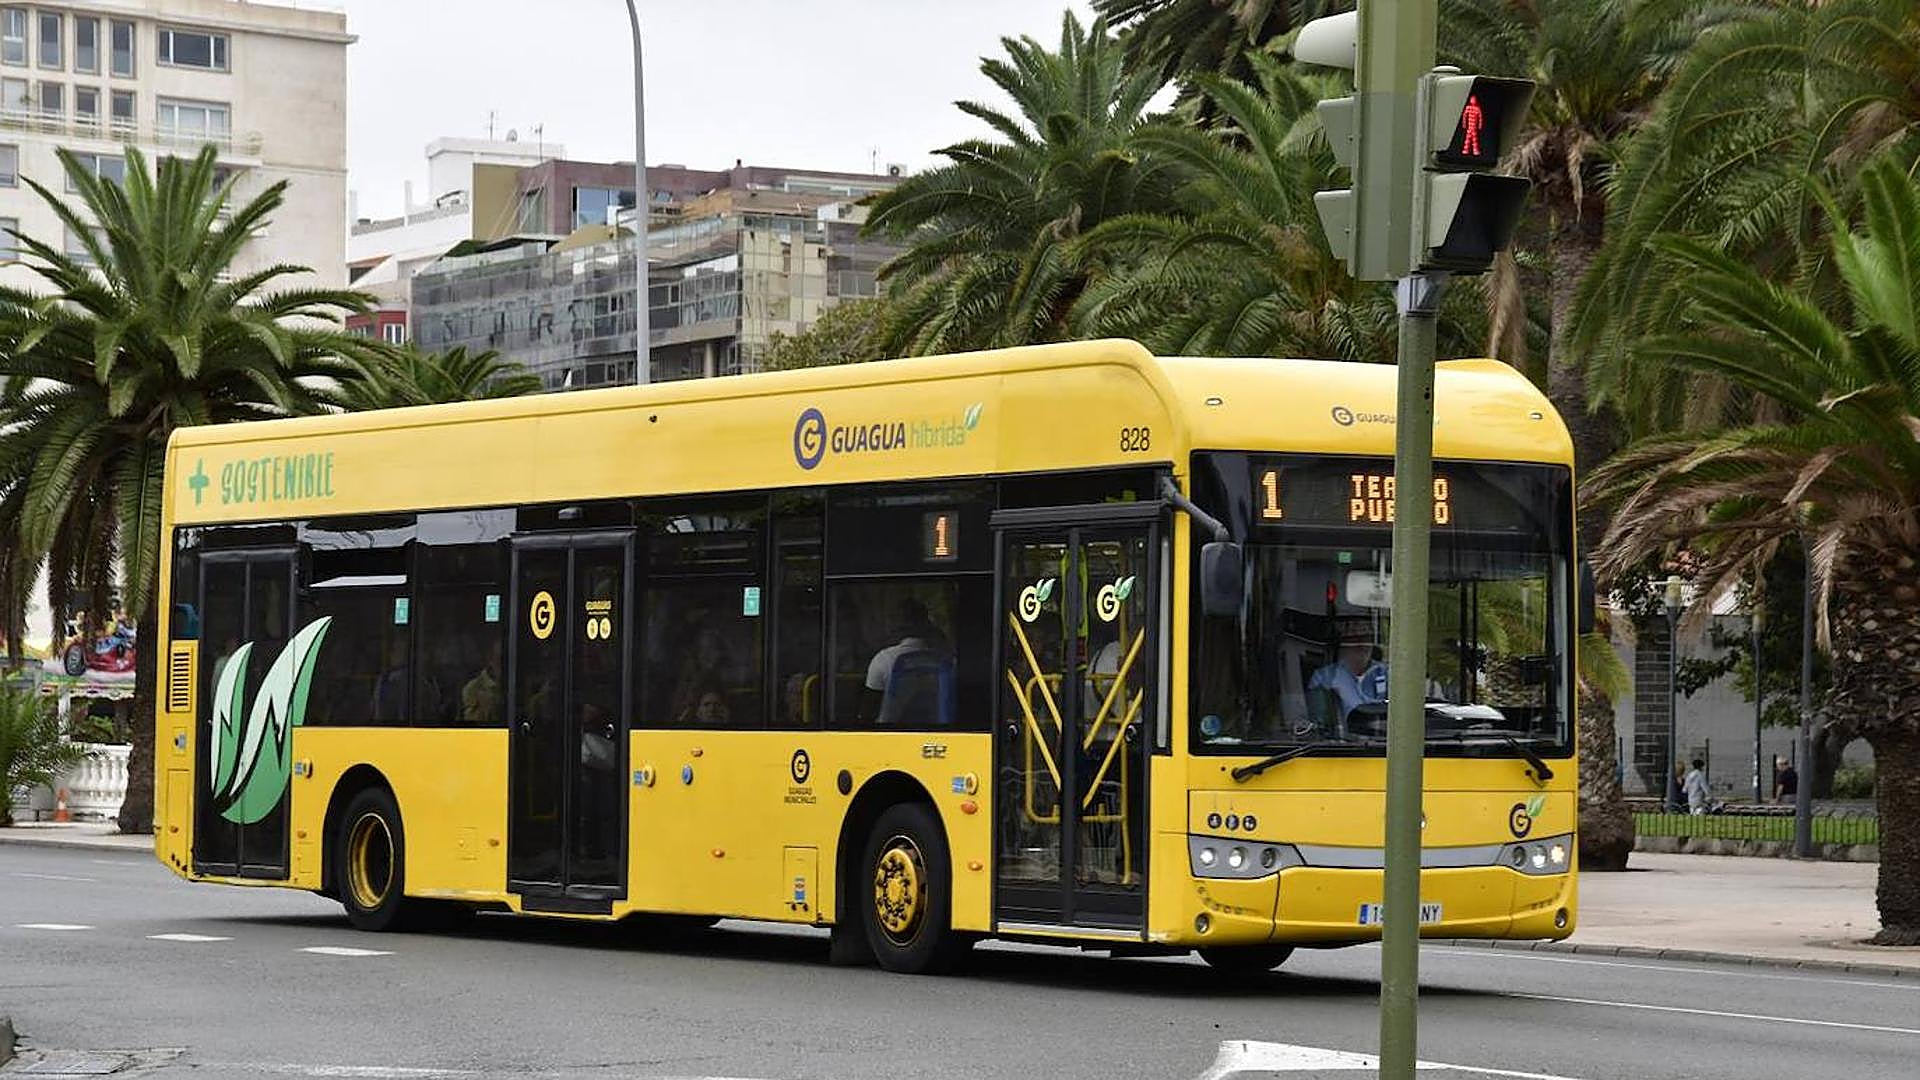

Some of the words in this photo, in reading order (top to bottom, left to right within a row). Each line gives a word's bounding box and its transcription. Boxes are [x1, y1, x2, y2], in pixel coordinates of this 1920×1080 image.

[1356, 411, 1396, 424] GUAGU
[832, 422, 906, 453] GUAGUA
[1121, 427, 1150, 452] 828
[221, 452, 335, 504] SOSTENIBLE
[1351, 474, 1448, 501] TEAO
[1262, 471, 1283, 518] 1
[1351, 499, 1449, 524] PUEO
[935, 516, 950, 556] 1
